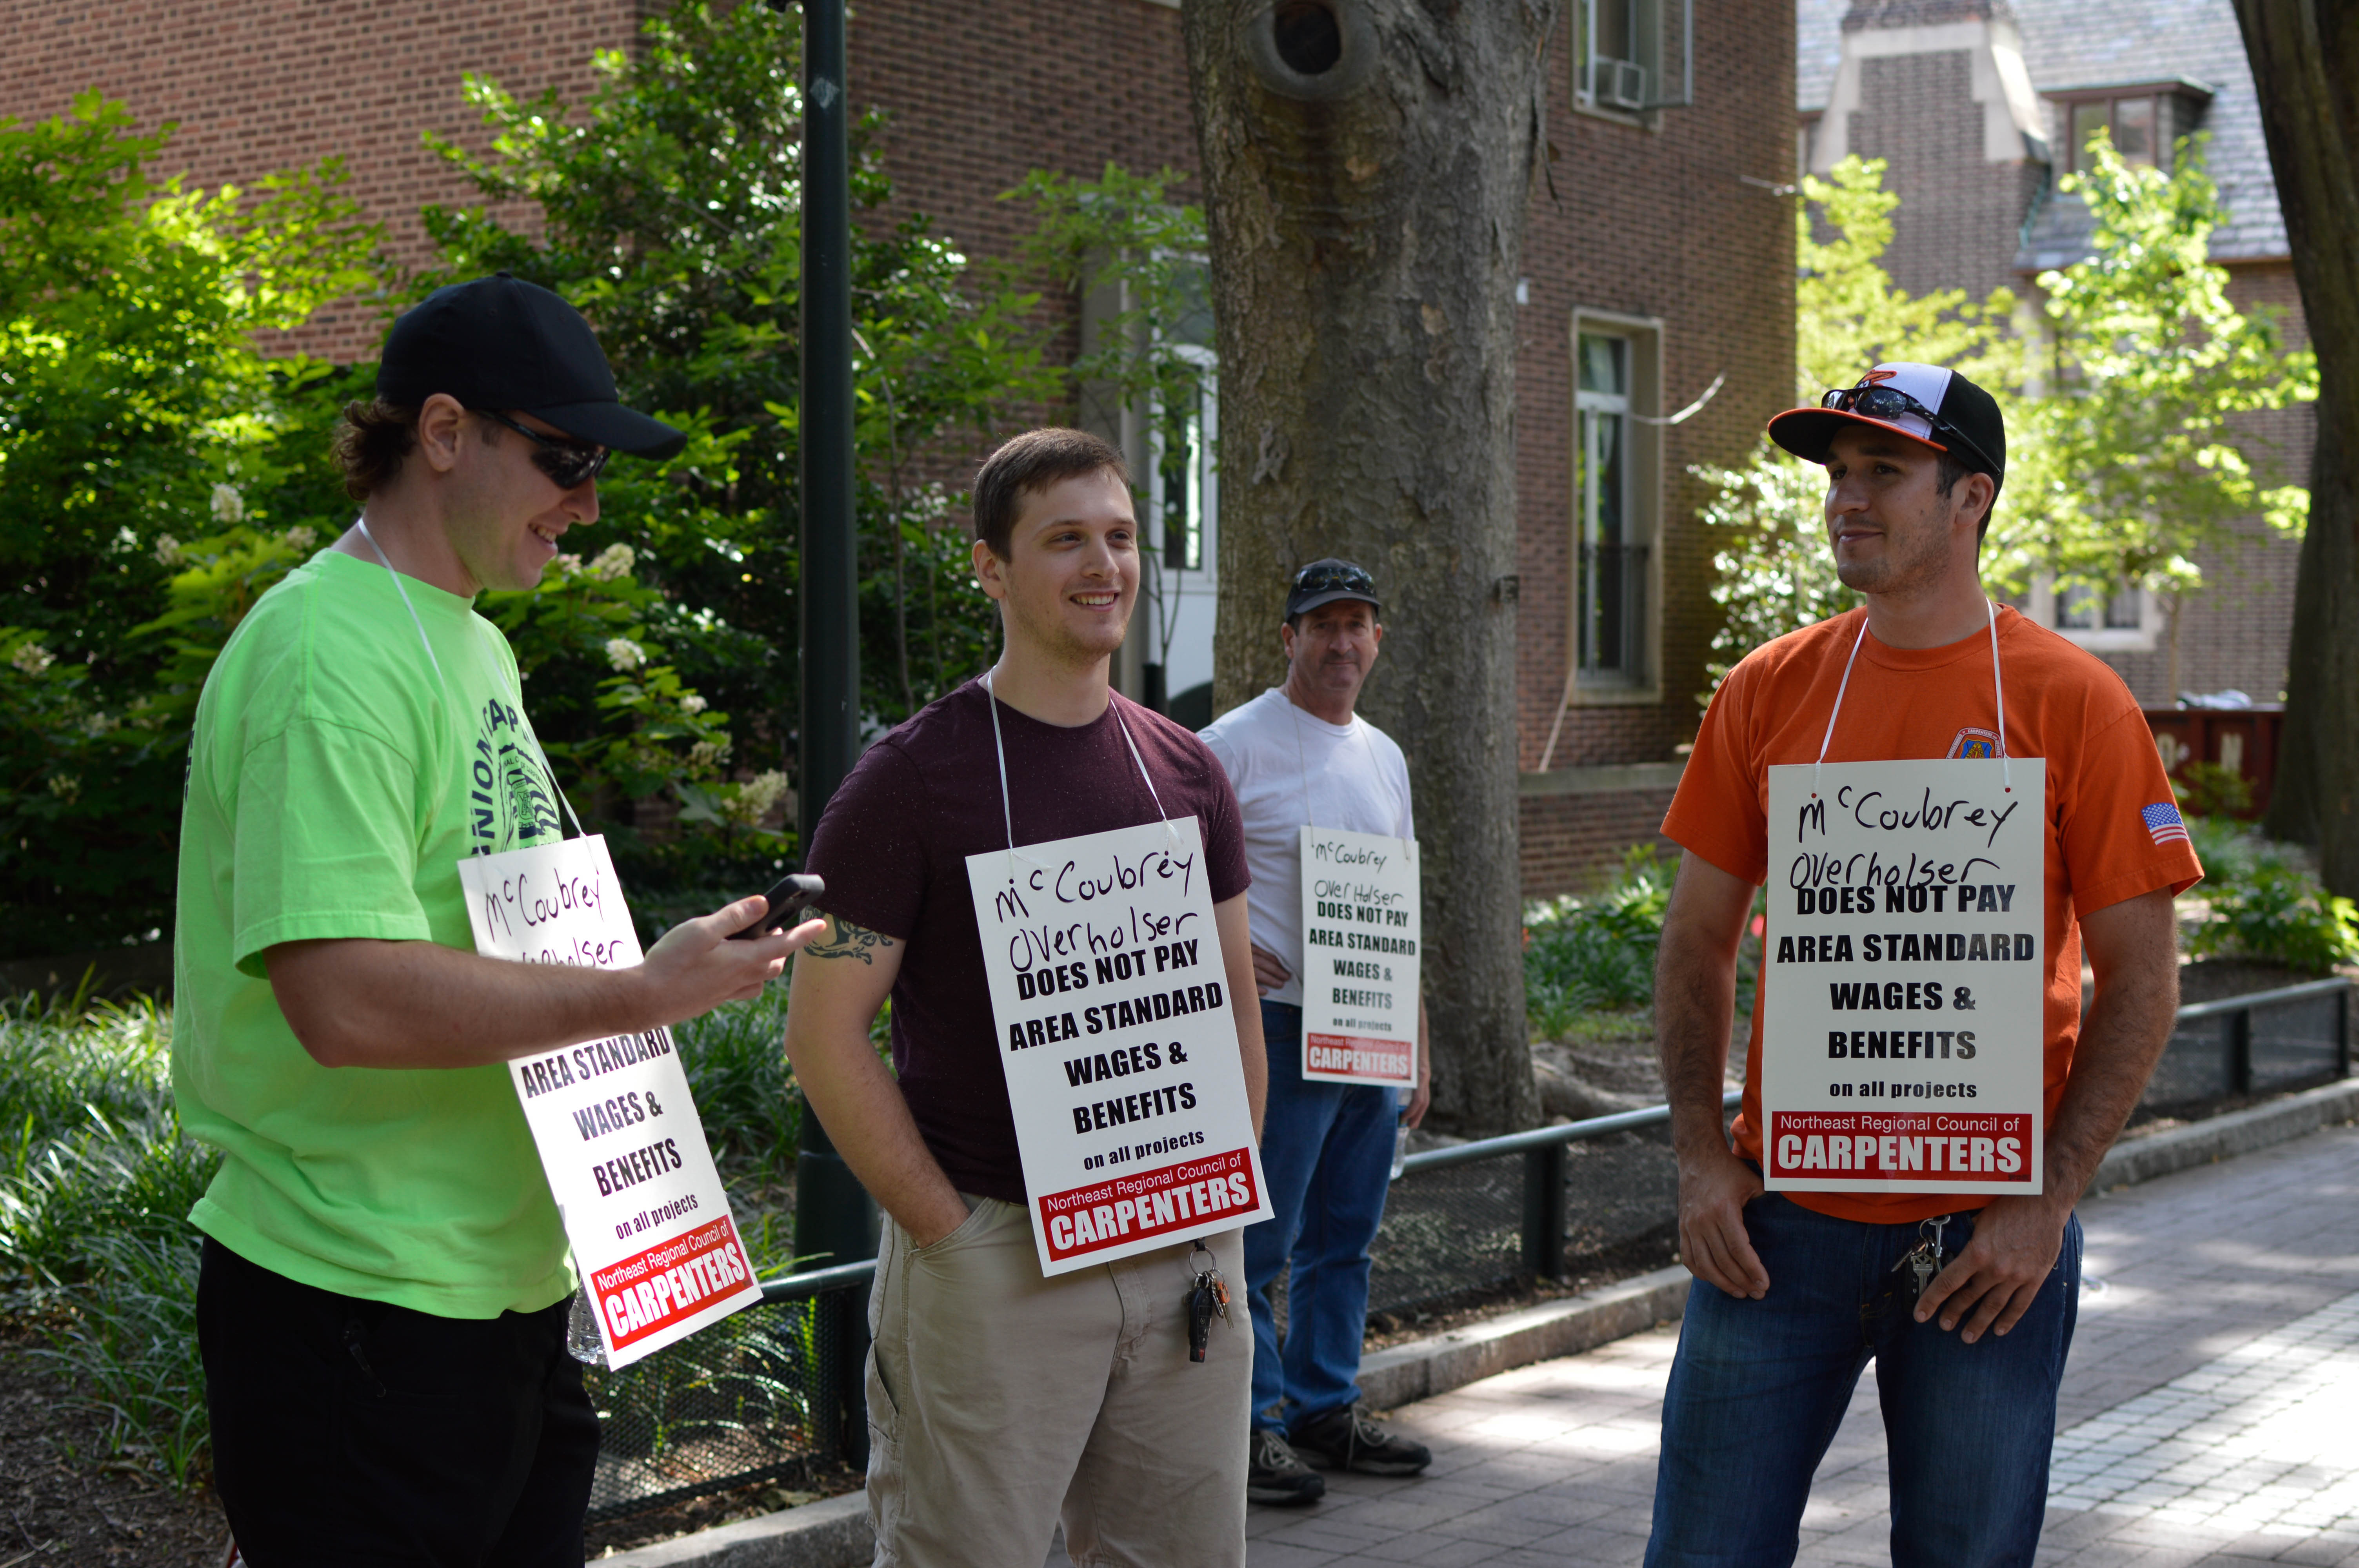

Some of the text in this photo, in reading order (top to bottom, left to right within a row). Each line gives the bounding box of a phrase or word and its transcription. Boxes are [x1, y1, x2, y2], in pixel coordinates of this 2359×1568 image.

[1968, 729, 1993, 737] CARPENTERS
[1318, 901, 1407, 926] DOES NOT PAY
[1797, 885, 2015, 915] DOES NOT PAY
[1310, 929, 1415, 955] AREA STANDARD
[1777, 934, 2034, 963] AREA STANDARD
[1017, 939, 1198, 1000] DOES NOT PAY
[1334, 960, 1392, 981] WAGES &
[1333, 988, 1392, 1009] BENEFITS
[1830, 982, 1975, 1010] WAGES &
[1010, 982, 1223, 1051] AREA STANDARD
[1333, 1018, 1392, 1031] on all projects
[521, 1027, 670, 1098] AREA STANDARD
[1310, 1047, 1408, 1075] CARPENTERS
[1828, 1031, 1976, 1059] BENEFITS
[1064, 1042, 1188, 1087] WAGES &
[1073, 1083, 1196, 1134] BENEFITS
[1830, 1082, 1976, 1098] on all projects
[572, 1091, 663, 1141] WAGES &
[1781, 1116, 2019, 1132] Northeast Regional Council of
[593, 1138, 682, 1197] BENEFITS
[1084, 1132, 1204, 1170] on all projects
[1778, 1134, 2021, 1172] CARPENTERS
[1048, 1153, 1240, 1212] Northeast Regional Council of
[616, 1194, 698, 1239] on all projects
[1051, 1172, 1249, 1250] CARPENTERS
[597, 1221, 729, 1291] Northeast Regional Council of
[606, 1243, 745, 1337] CARPENTERS
